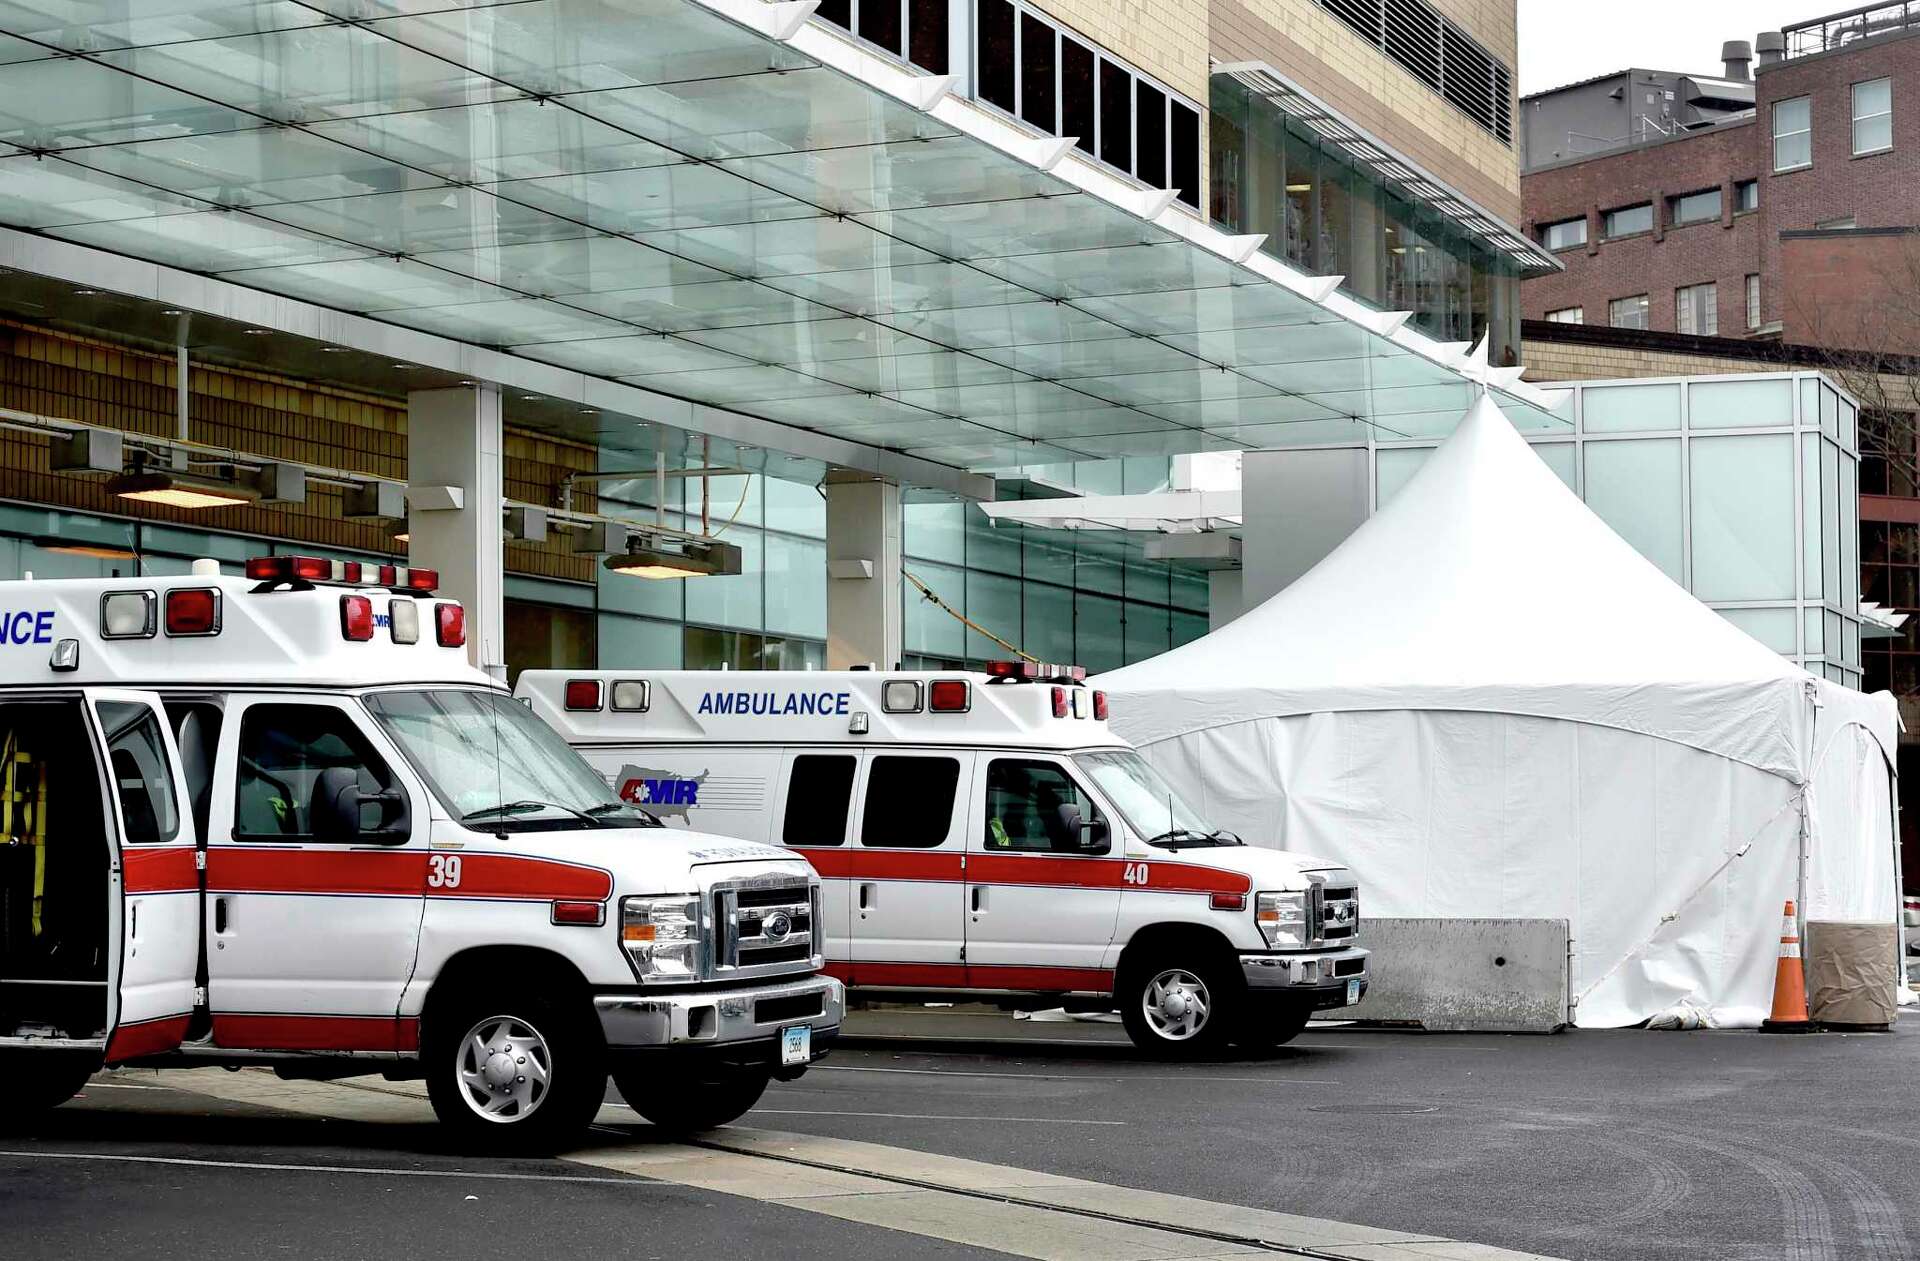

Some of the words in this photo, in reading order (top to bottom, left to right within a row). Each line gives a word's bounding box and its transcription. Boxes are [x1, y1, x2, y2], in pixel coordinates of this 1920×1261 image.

[372, 614, 391, 628] MR
[698, 692, 850, 715] AMBULANCE
[620, 778, 698, 805] AMR
[428, 855, 462, 888] 39
[1123, 862, 1149, 885] 40
